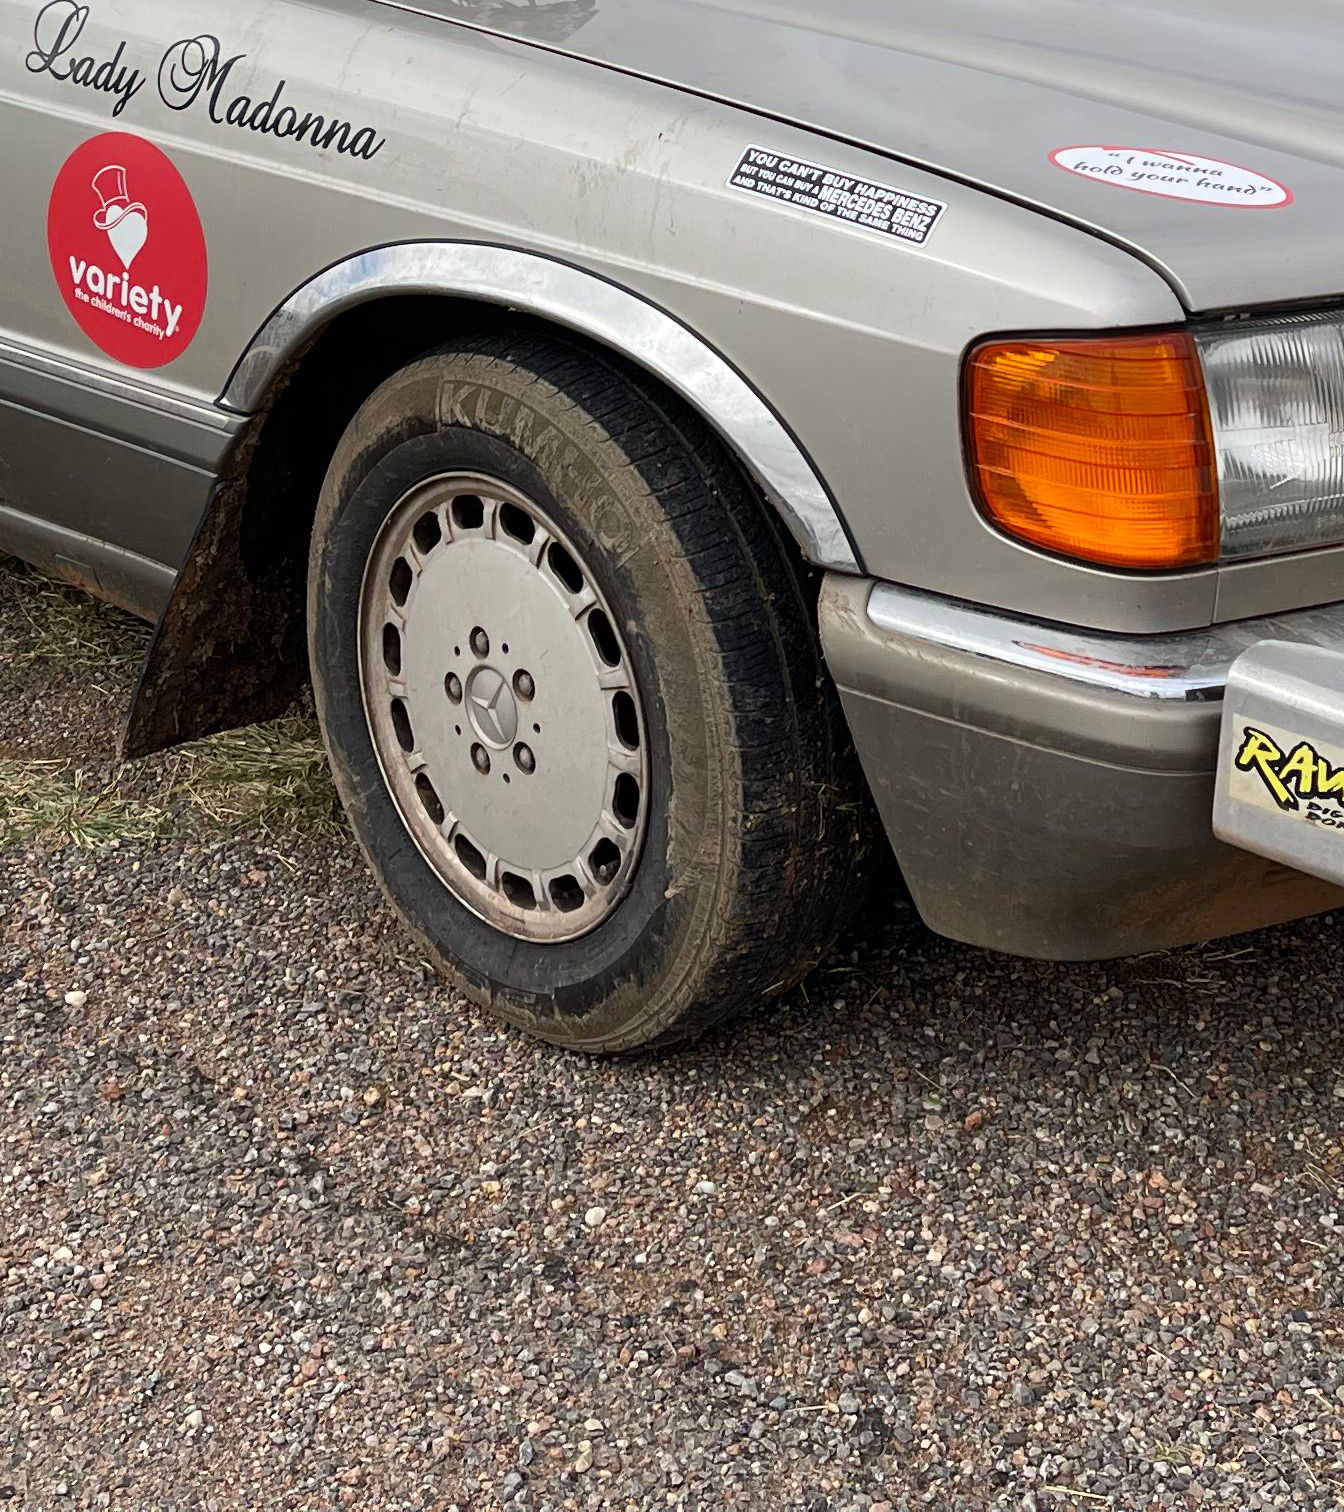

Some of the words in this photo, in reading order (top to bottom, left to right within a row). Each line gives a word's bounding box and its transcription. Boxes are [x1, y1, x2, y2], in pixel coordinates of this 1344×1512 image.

[157, 33, 386, 161] Madonna
[739, 163, 759, 176] BUT
[757, 168, 777, 182] YOU
[775, 173, 795, 187] CAN
[793, 178, 815, 193] BUY
[810, 185, 820, 195] A
[817, 184, 894, 219] MERCEDES
[891, 208, 934, 232] BENZ
[748, 149, 779, 169] YOU
[778, 159, 824, 182] CAN'T
[822, 172, 856, 191] BUY
[854, 180, 939, 217] HAPPINESS
[1073, 161, 1124, 177] hold
[1127, 169, 1189, 185] your
[1142, 159, 1224, 178] wanna
[732, 175, 756, 189] AND
[756, 180, 793, 201] THAT'S
[791, 191, 819, 209] KIND
[819, 200, 837, 213] OF
[836, 205, 859, 221] THE
[857, 213, 892, 230] SAME
[890, 222, 925, 242] THING
[68, 255, 183, 338] variety
[74, 287, 90, 303] the
[90, 296, 132, 323] children's
[132, 315, 165, 341] charity
[1306, 801, 1344, 819] DIG
